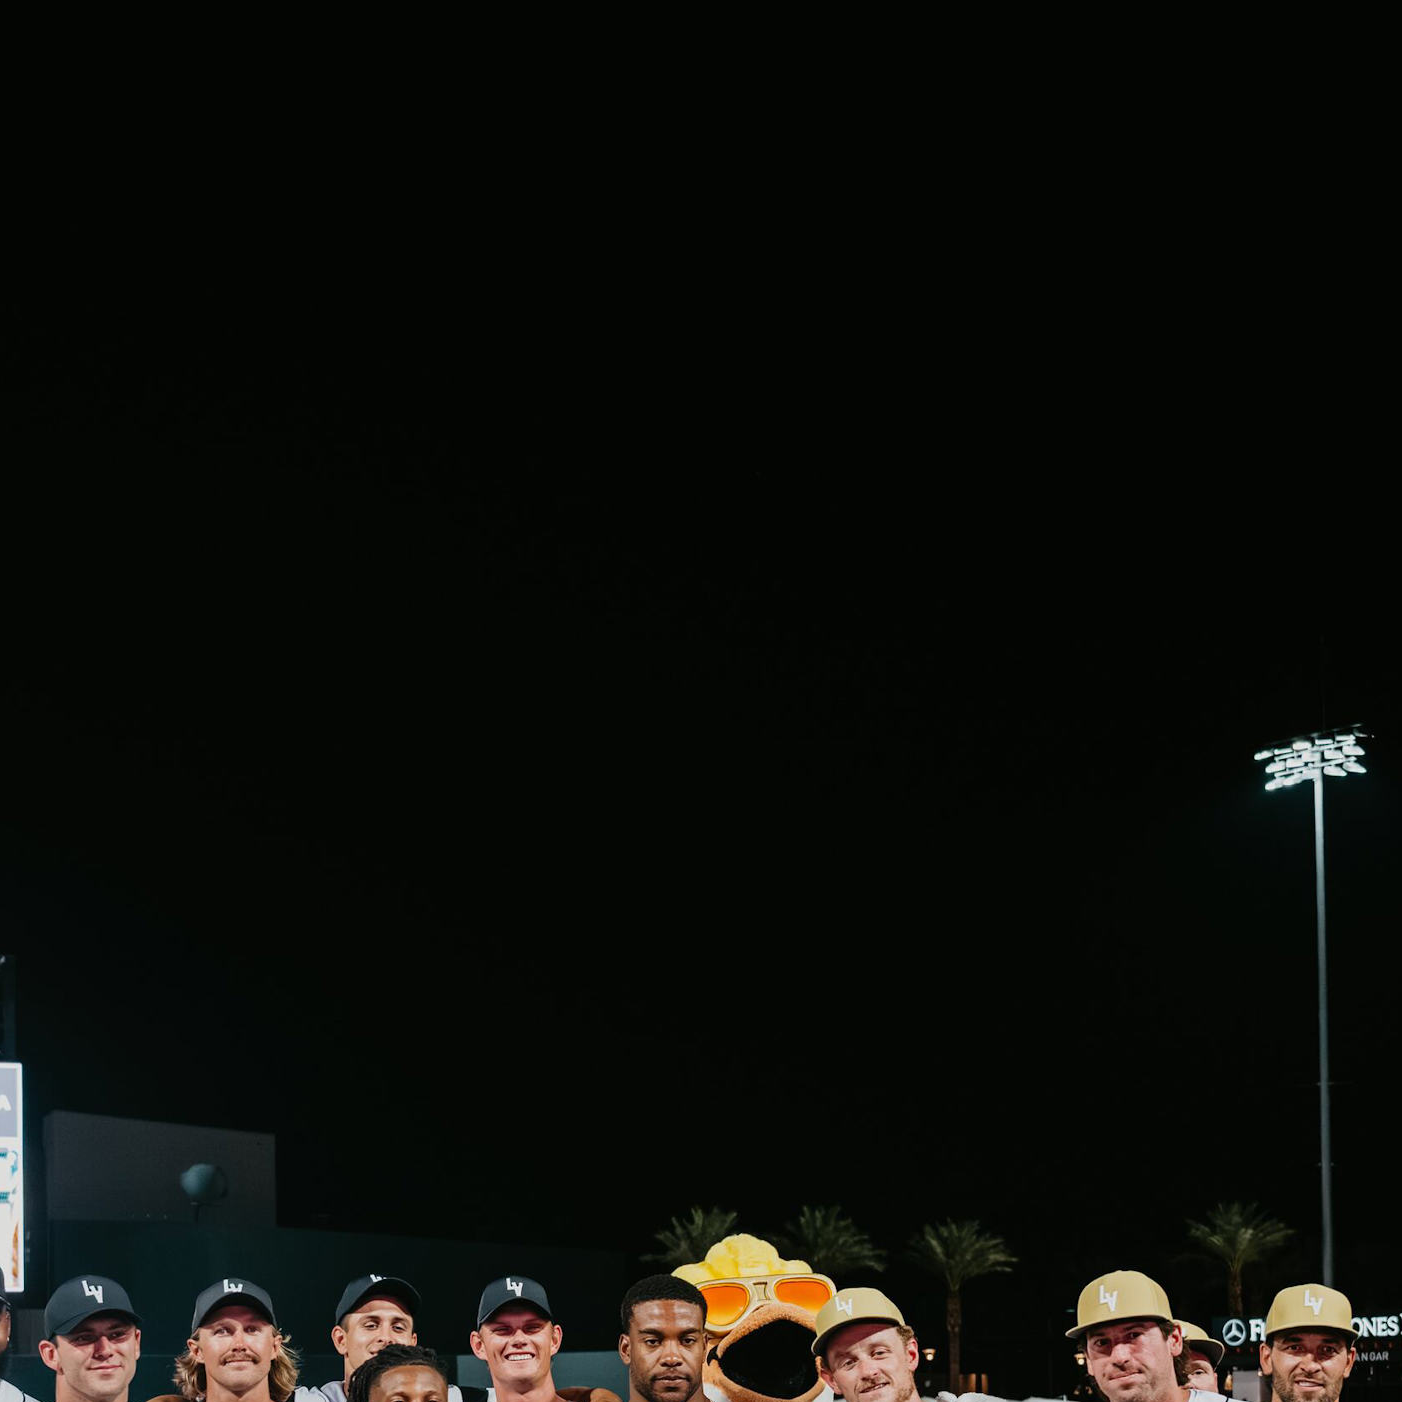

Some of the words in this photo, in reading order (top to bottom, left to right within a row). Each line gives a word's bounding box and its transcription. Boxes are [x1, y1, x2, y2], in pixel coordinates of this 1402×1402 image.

[82, 1279, 103, 1304] LV
[506, 1277, 524, 1297] LV
[835, 1295, 854, 1317] LV
[1098, 1285, 1118, 1312] LV
[1304, 1288, 1324, 1316] LV
[1350, 1316, 1399, 1338] ONES
[1354, 1351, 1390, 1363] ANGAR
